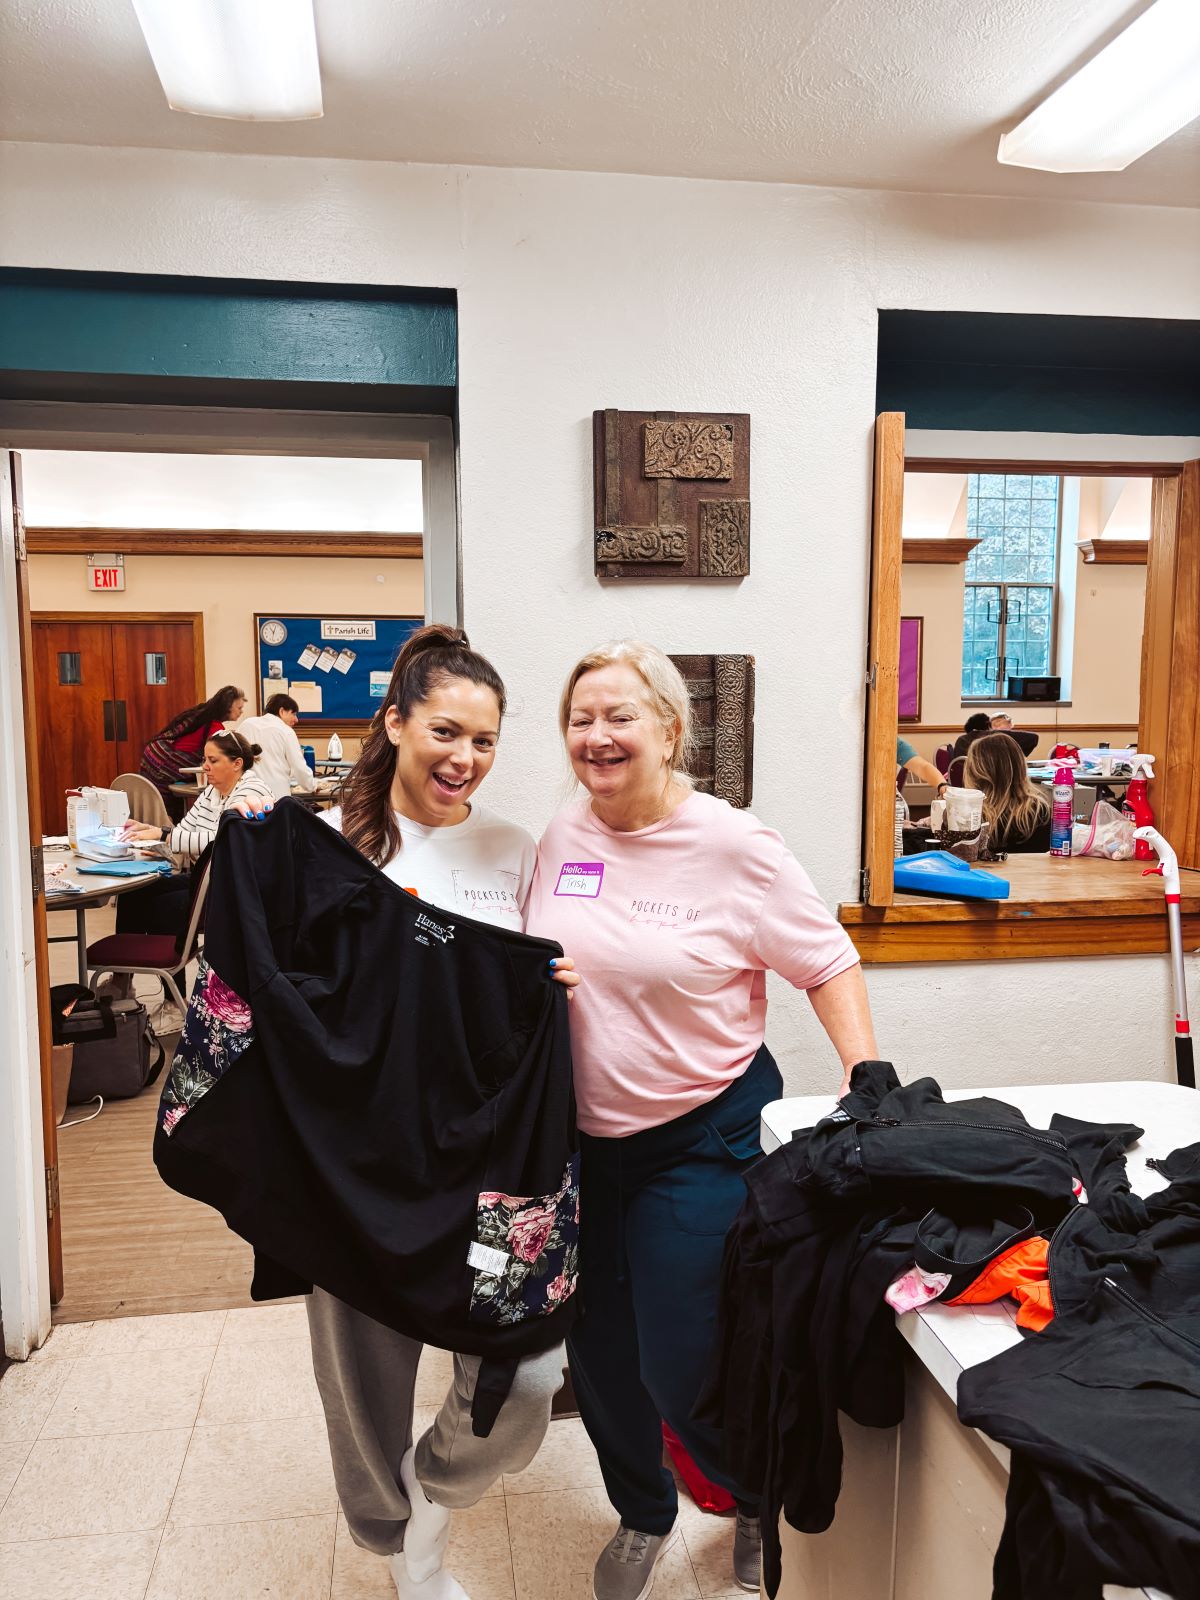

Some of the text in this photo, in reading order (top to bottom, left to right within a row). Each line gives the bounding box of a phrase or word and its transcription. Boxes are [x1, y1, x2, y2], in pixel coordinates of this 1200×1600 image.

[94, 569, 118, 587] EXIT
[334, 627, 356, 635] Parish
[562, 865, 583, 874] Hello
[564, 877, 587, 890] Trish
[464, 889, 507, 901] POCKETS
[631, 900, 701, 921] POCKETS OF
[416, 913, 446, 935] Hanes
